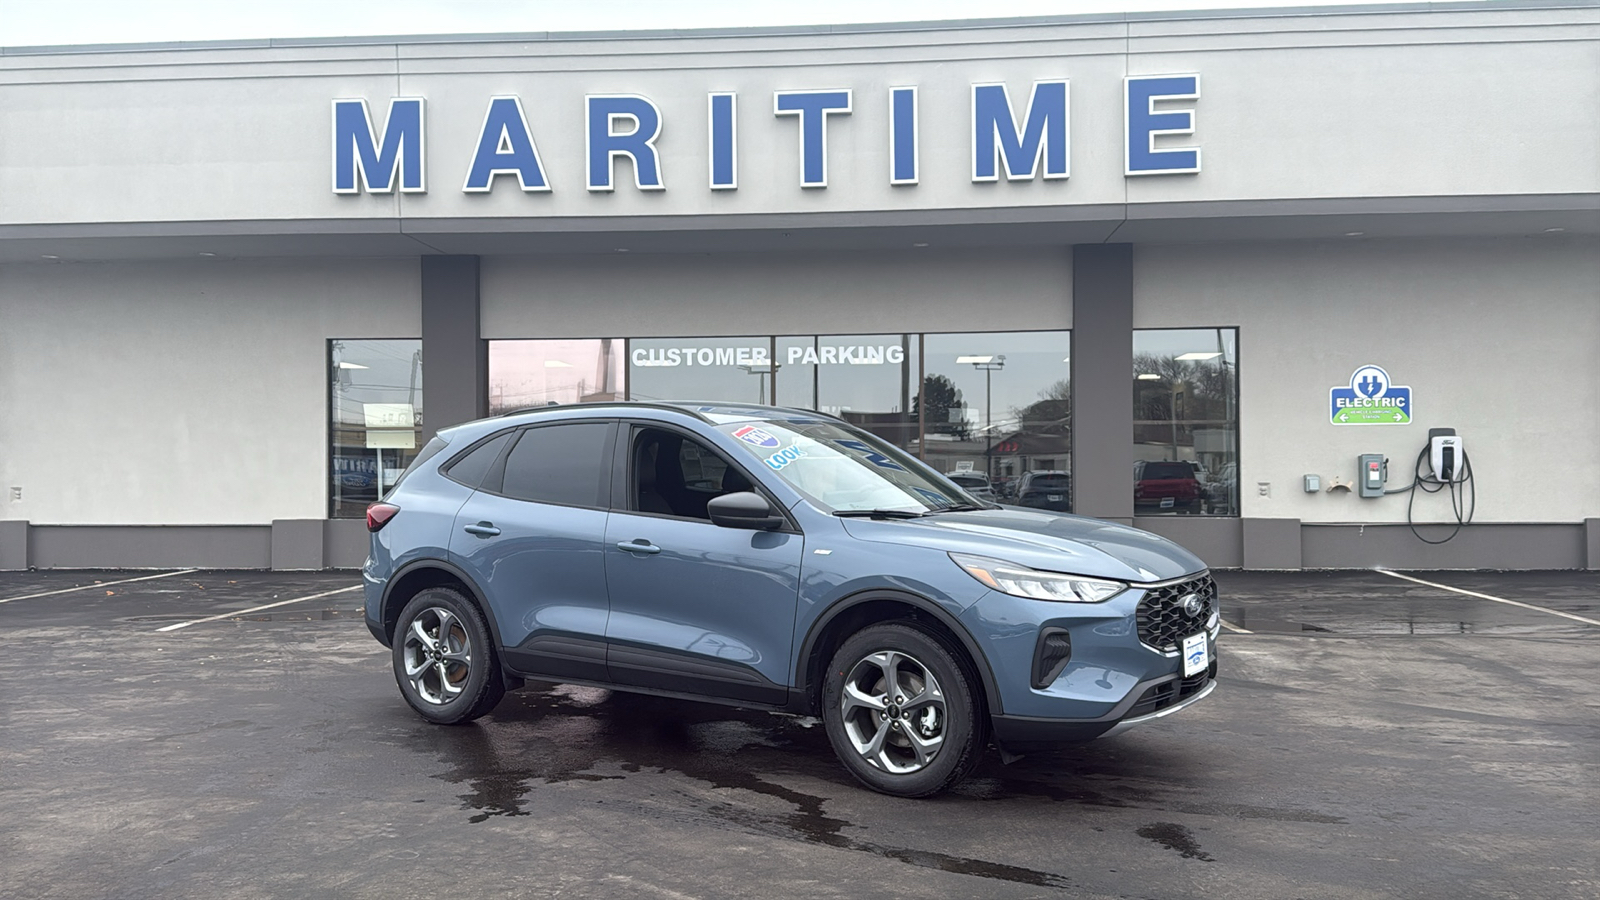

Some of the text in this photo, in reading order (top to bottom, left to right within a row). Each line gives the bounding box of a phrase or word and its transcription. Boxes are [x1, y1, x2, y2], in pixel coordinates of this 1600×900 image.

[331, 75, 1202, 194] MARITIME
[631, 344, 905, 367] CUSTOMER PARKING
[1336, 397, 1406, 408] ELECTRIC
[765, 444, 805, 470] LOOK
